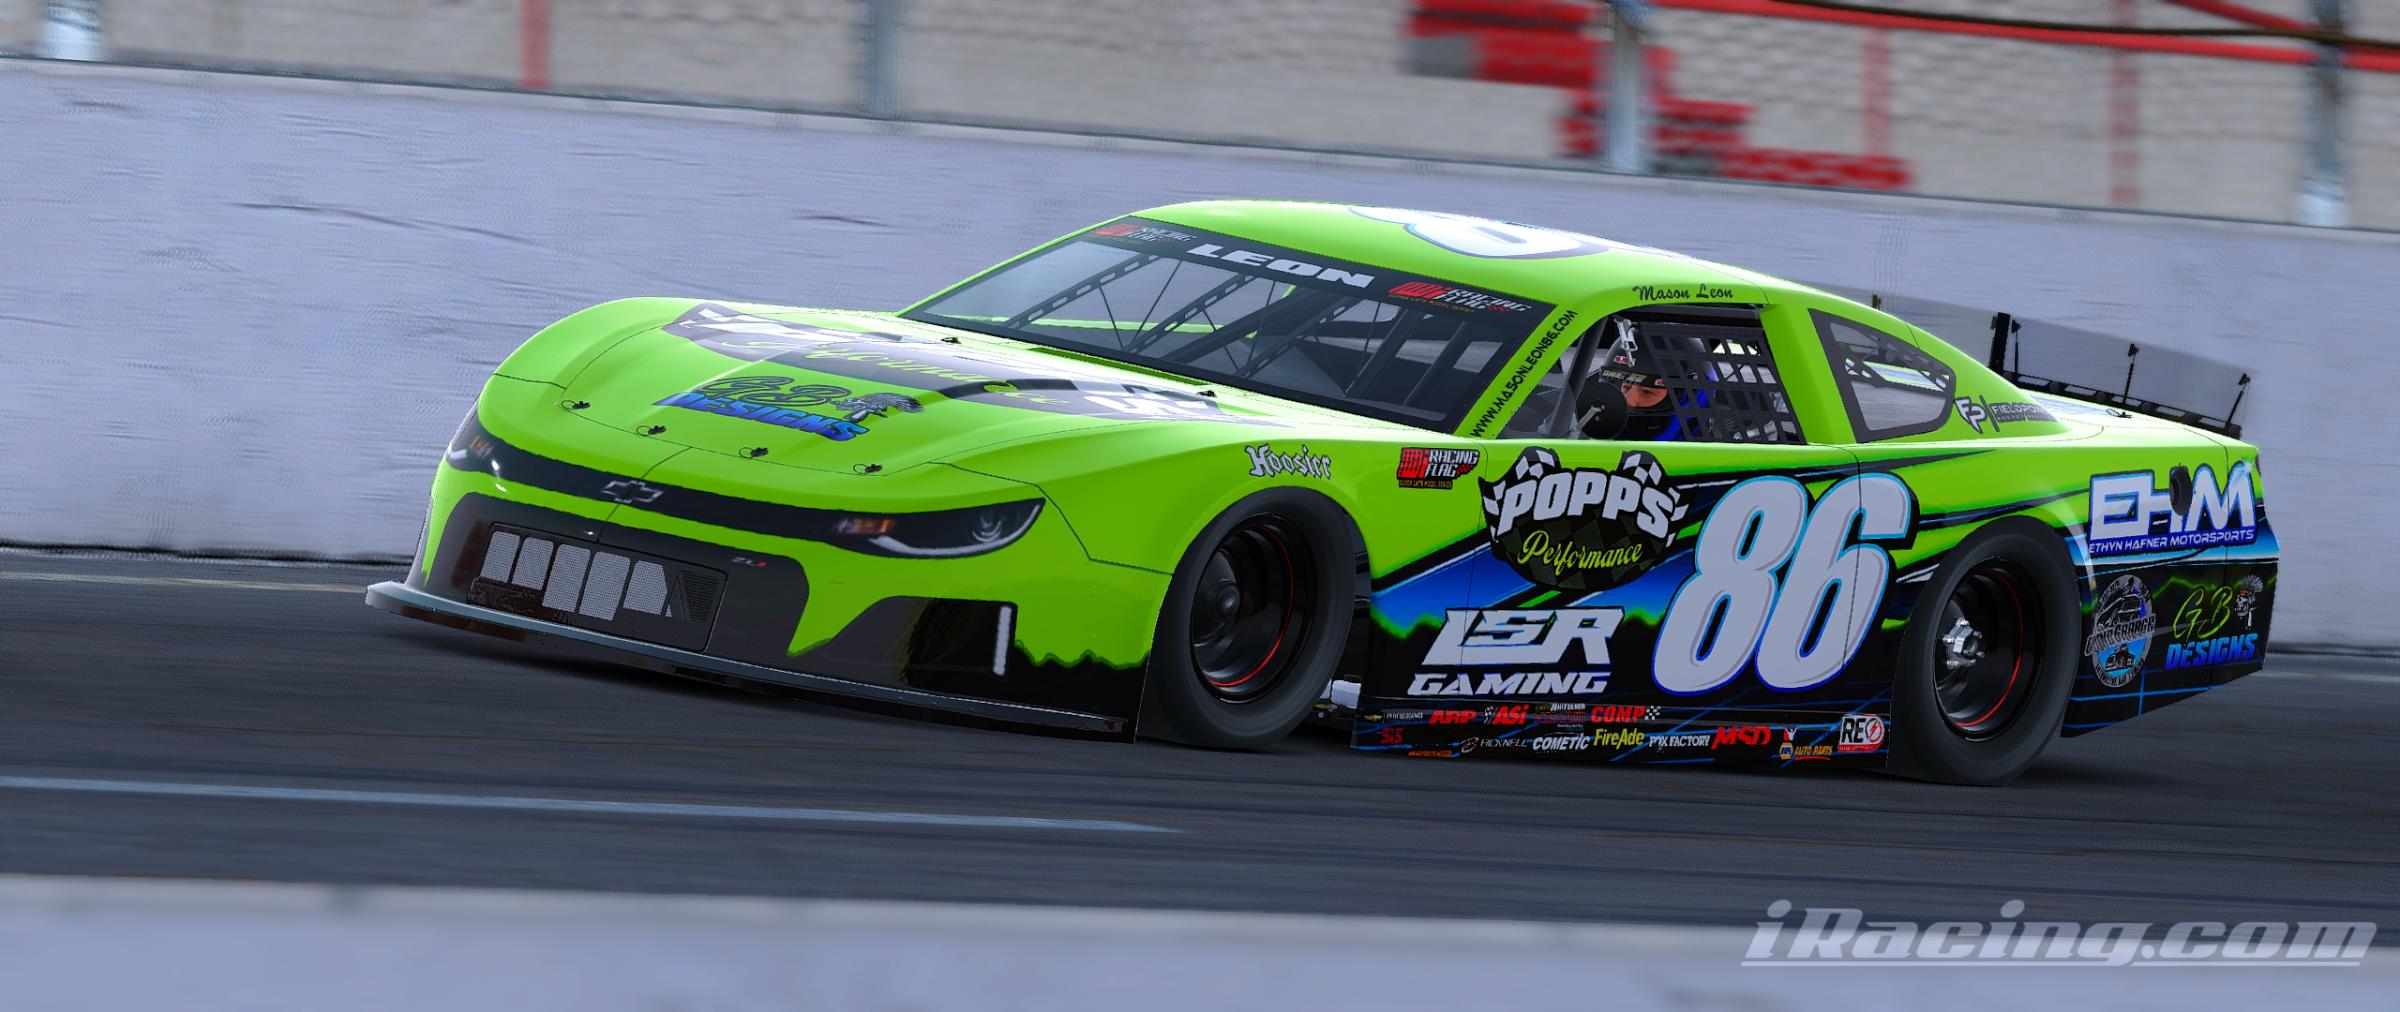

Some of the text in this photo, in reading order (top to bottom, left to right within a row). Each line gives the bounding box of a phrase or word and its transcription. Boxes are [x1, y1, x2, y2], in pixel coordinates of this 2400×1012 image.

[1187, 243, 1375, 288] LEON
[1632, 283, 1733, 301] Mason Leon
[652, 392, 869, 441] DESIGNS
[1244, 443, 1331, 480] Hoosier
[1428, 449, 1478, 464] RACING
[1424, 463, 1459, 478] FLAG
[1497, 471, 1674, 539] POPPS
[2090, 461, 2255, 540] EHM
[1517, 530, 1643, 576] Performance
[2089, 529, 2254, 554] ETHYN HAFNER MOTORSPORTS
[1652, 472, 1912, 693] 86
[2173, 586, 2233, 642] GB
[2164, 632, 2258, 669] DESIGNS
[1407, 672, 1612, 695] GAMING
[1428, 710, 1477, 726] ARP
[1590, 705, 1646, 723] COMP
[1532, 733, 1591, 750] COMETIC
[1593, 728, 1645, 750] FireAde
[1668, 735, 1710, 747] FACTORY
[1711, 726, 1771, 750] MSD
[1794, 745, 1812, 756] AUTO
[1814, 745, 1833, 756] PARTS
